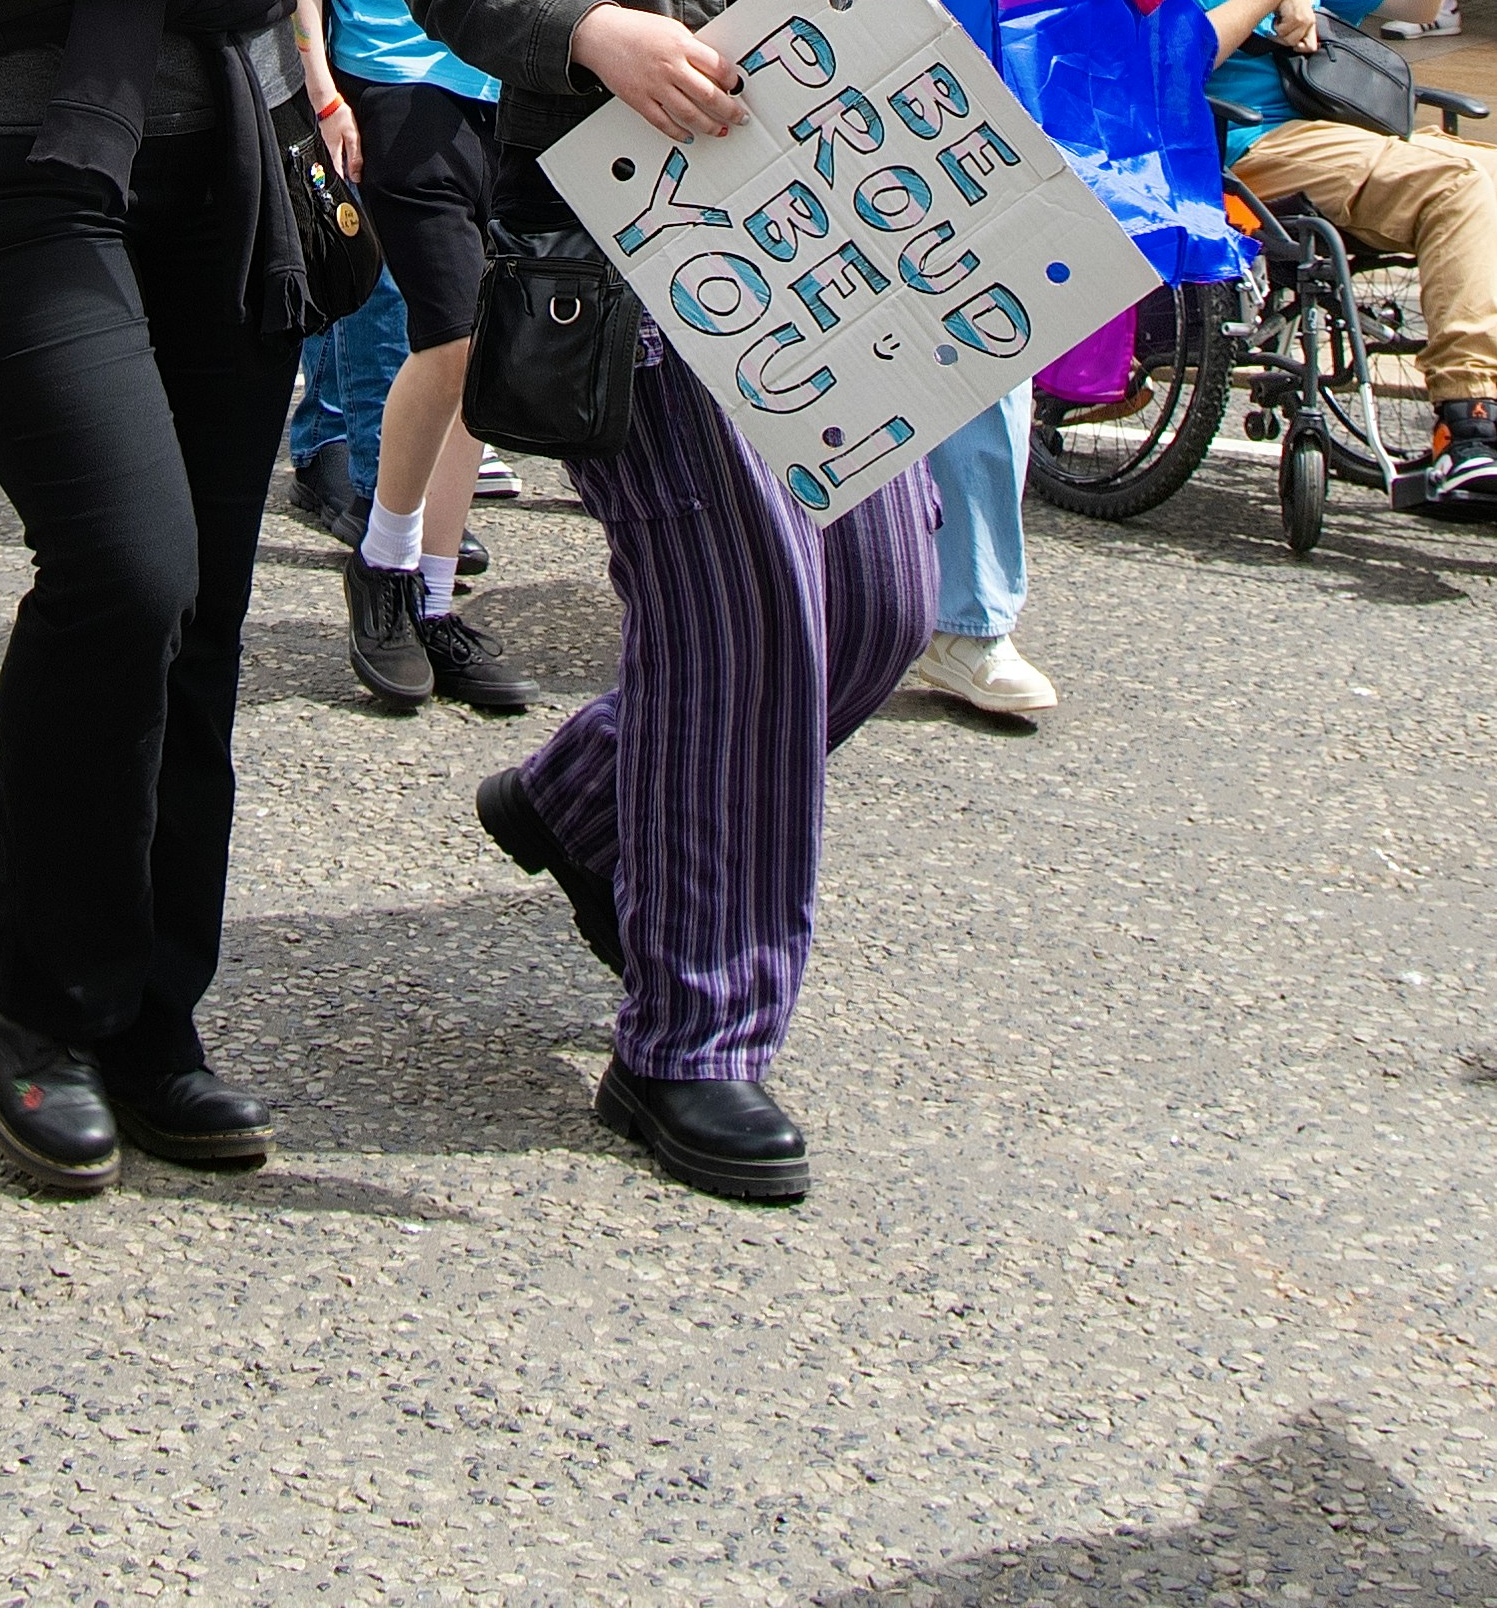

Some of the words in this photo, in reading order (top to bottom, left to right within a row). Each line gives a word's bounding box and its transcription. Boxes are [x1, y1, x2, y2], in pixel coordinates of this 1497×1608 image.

[736, 14, 1032, 359] PROUD
[888, 60, 1023, 207] BE
[743, 178, 892, 334] BE
